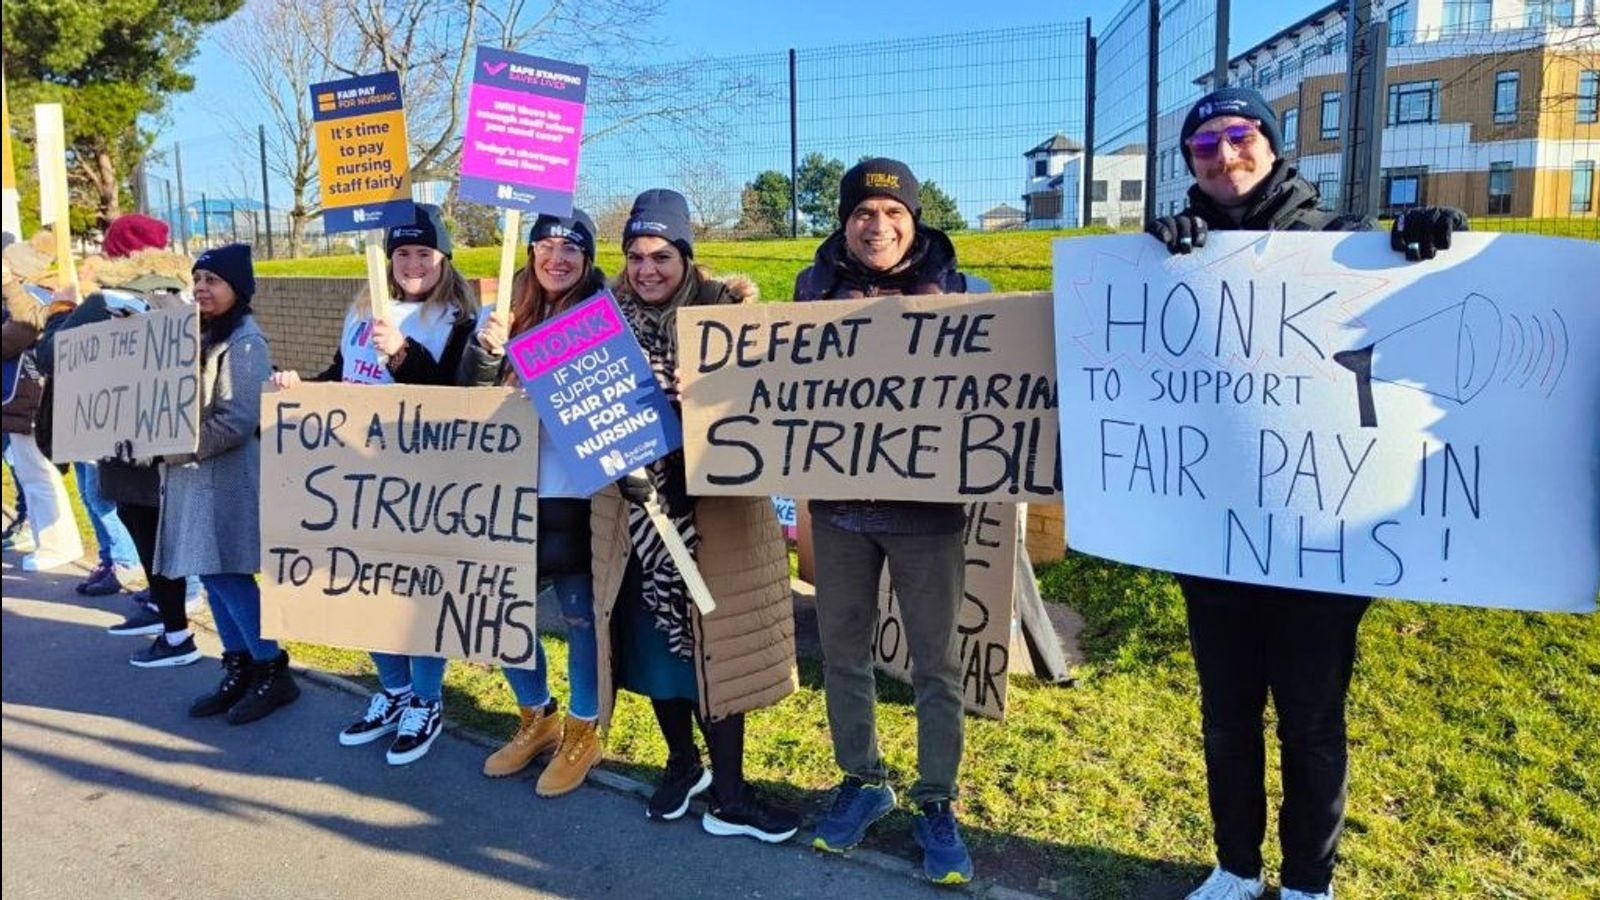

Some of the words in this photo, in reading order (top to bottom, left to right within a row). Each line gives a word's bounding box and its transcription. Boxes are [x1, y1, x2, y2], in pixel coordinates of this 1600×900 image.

[337, 88, 357, 100] FAIR
[358, 86, 377, 96] PAY
[338, 97, 356, 109] FOR
[357, 92, 397, 106] NURSING
[331, 127, 353, 141] It's
[356, 122, 390, 137] time
[340, 145, 355, 157] to
[358, 141, 384, 157] pay
[329, 176, 362, 195] staff
[365, 173, 404, 190] fairly
[336, 157, 392, 176] nursing
[57, 336, 100, 376] FUND
[110, 329, 139, 358] THE
[143, 312, 197, 372] NHS
[520, 309, 613, 370] HONK
[697, 318, 872, 374] DEFEAT
[902, 313, 996, 358] THE
[1106, 280, 1338, 361] HONK
[354, 360, 383, 379] THE
[550, 356, 630, 409] SUPPORT
[553, 368, 570, 386] IF
[570, 347, 610, 375] YOU
[1083, 366, 1122, 402] TO
[1148, 368, 1312, 406] SUPPORT
[74, 386, 129, 436] NOT
[135, 375, 197, 441] WAR
[559, 394, 602, 426] FAIR
[602, 374, 637, 402] PAY
[588, 403, 628, 431] FOR
[277, 402, 347, 454] FOR
[364, 412, 387, 450] A
[398, 400, 522, 454] UNIFIED
[574, 407, 658, 459] NURSING
[706, 415, 942, 485] STRIKE
[1099, 419, 1208, 500] FAIR
[1257, 429, 1377, 515] PAY
[1420, 441, 1480, 520] IN
[301, 465, 537, 544] STRUGGLE
[269, 547, 313, 586] TO
[323, 547, 444, 597] DEFEND
[457, 560, 517, 599] THE
[435, 591, 534, 664] NHS
[961, 635, 1008, 711] AR
